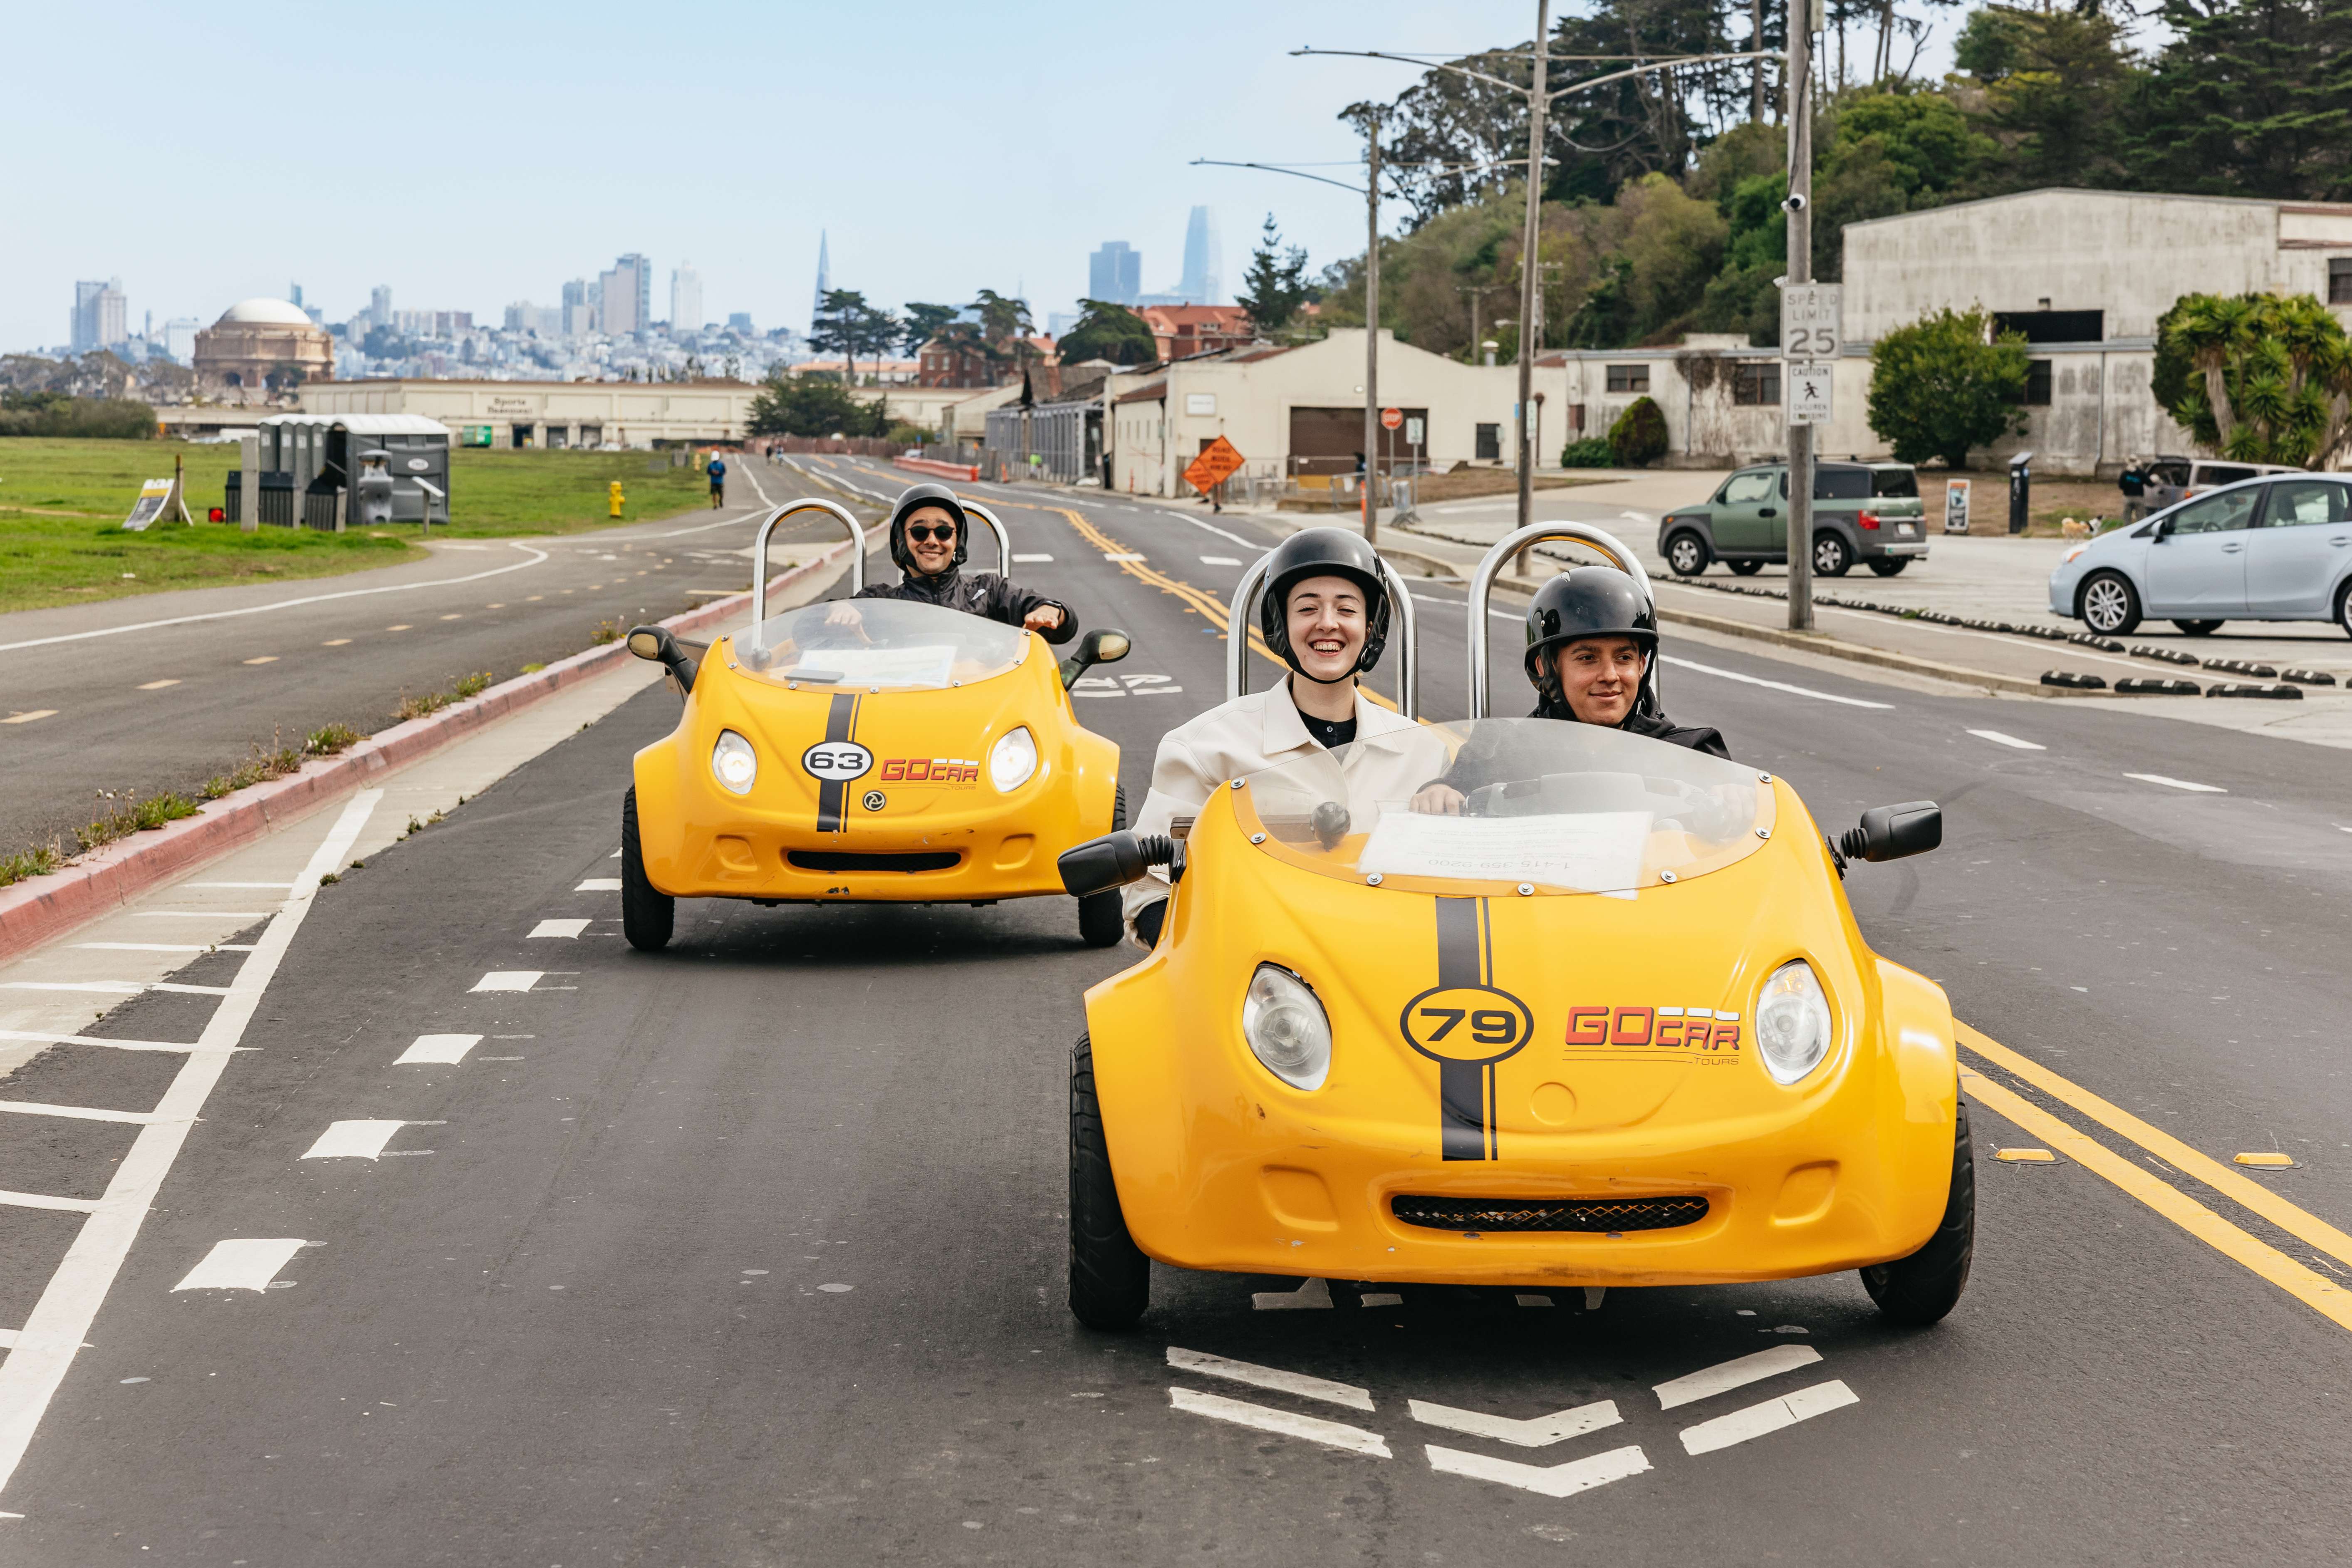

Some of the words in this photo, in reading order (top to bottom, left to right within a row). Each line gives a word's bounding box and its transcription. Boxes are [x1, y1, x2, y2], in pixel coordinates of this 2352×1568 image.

[1788, 294, 1837, 305] SPEED
[1792, 310, 1830, 320] LIMIT
[1790, 328, 1835, 354] 25
[1792, 368, 1829, 376] CAUTION
[810, 752, 863, 770] 63
[1428, 859, 1571, 869] 1-415-359-9200
[1421, 1008, 1517, 1044] 79
[1693, 1057, 1739, 1065] TOURS
